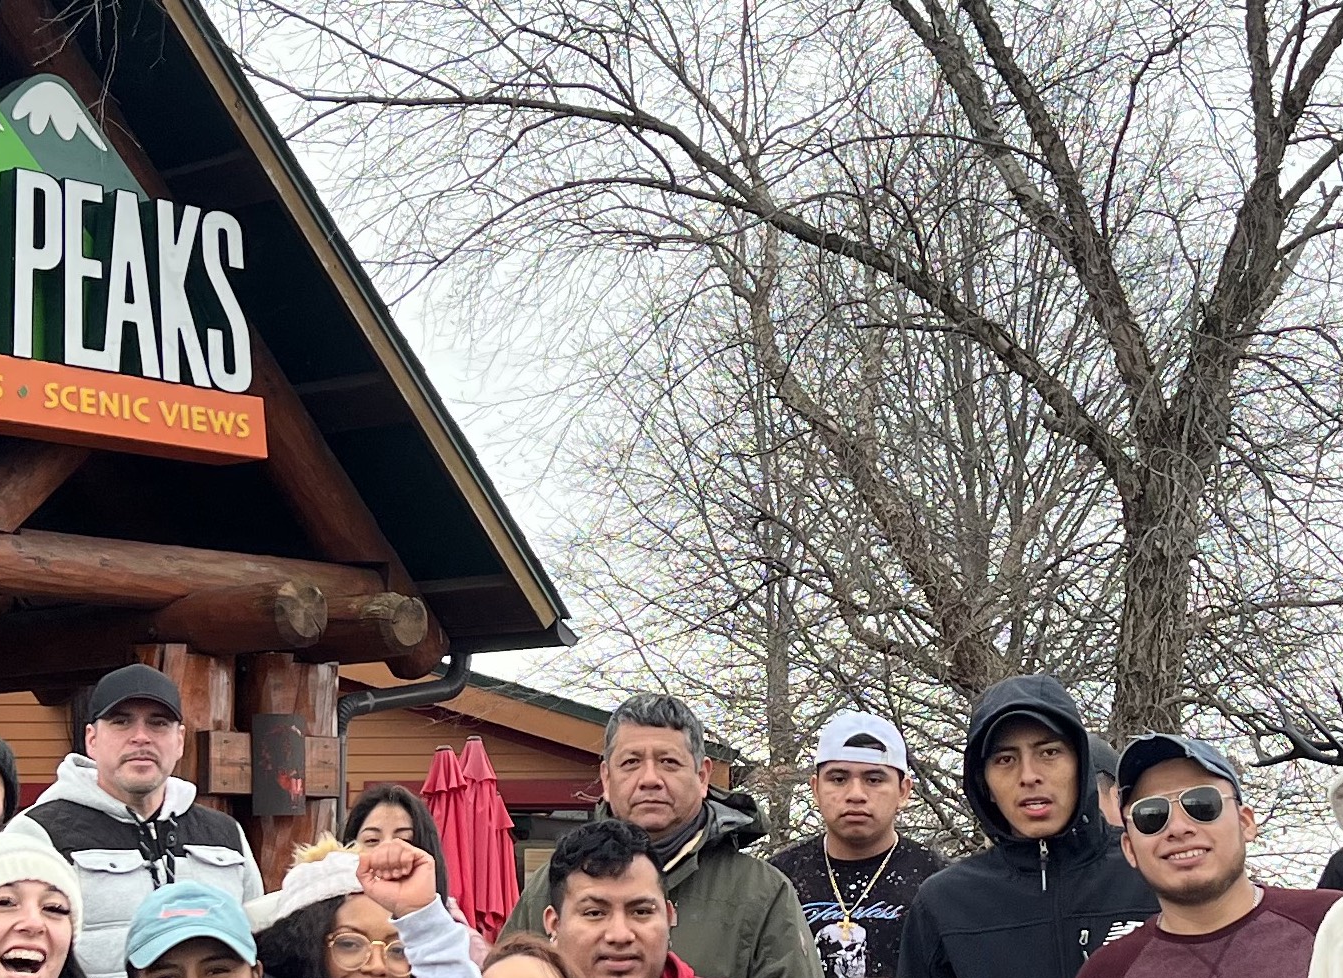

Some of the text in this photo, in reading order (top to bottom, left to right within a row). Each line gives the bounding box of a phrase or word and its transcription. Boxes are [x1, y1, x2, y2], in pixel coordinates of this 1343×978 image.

[13, 167, 254, 393] PEAKS
[43, 382, 151, 424] SCENIC
[158, 400, 251, 439] VIEWS
